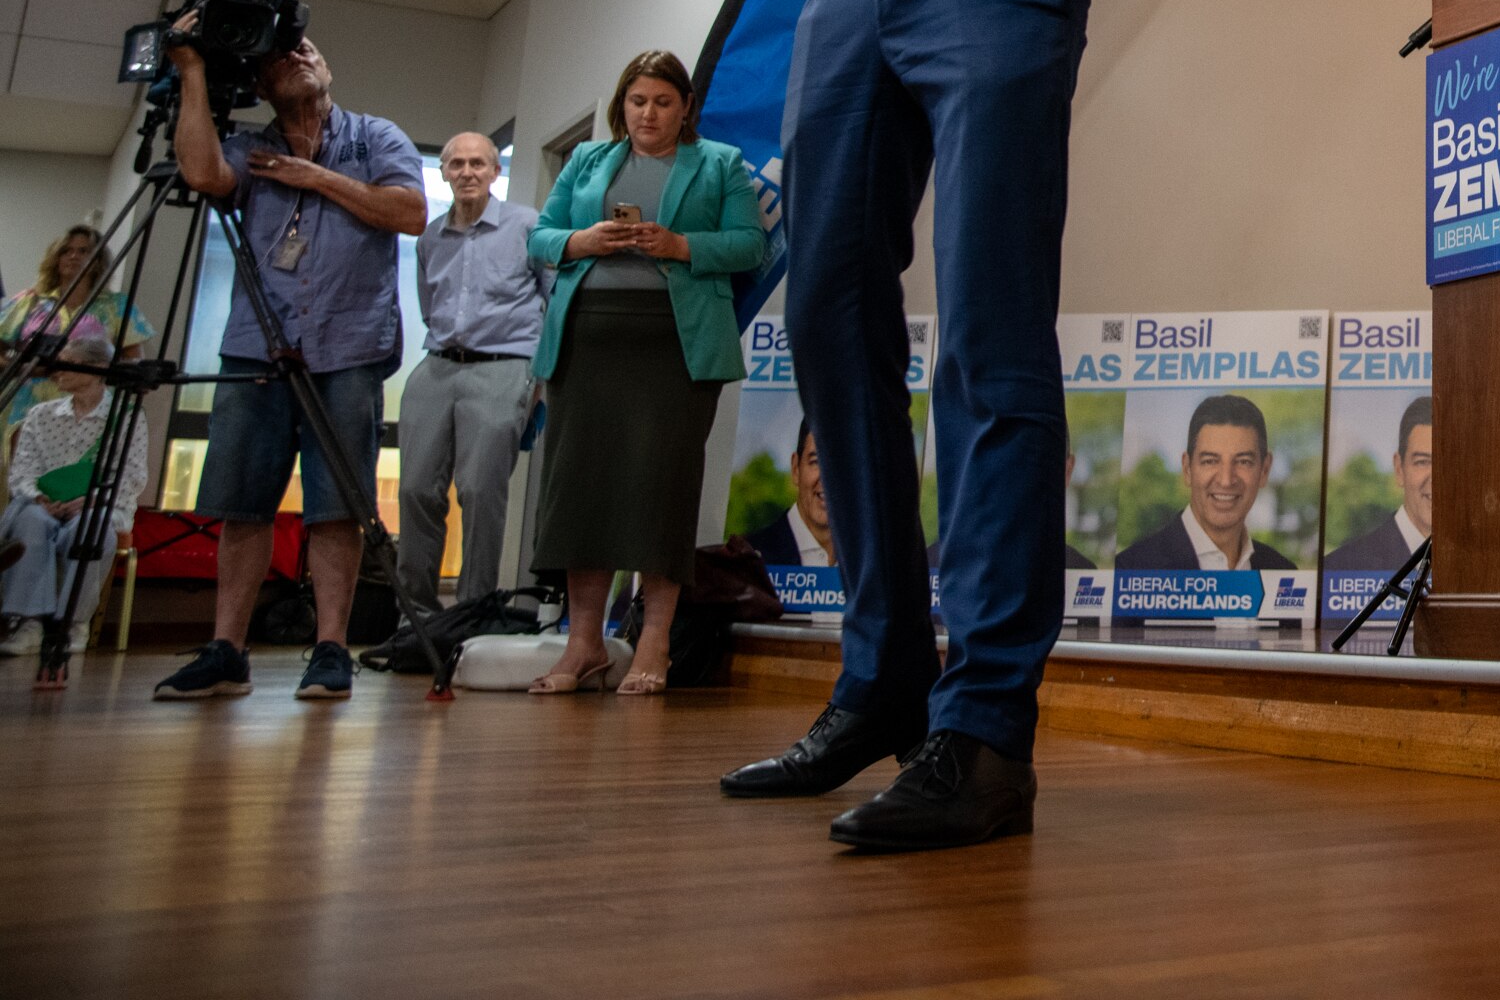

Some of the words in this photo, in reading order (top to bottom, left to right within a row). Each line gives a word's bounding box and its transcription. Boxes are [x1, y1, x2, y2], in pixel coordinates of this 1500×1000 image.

[1434, 55, 1500, 117] We're
[1437, 222, 1490, 252] LIBERAL
[1135, 318, 1213, 349] Basil
[1339, 317, 1420, 348] Basil
[1133, 350, 1321, 381] ZEMPILAS
[785, 572, 817, 588] FOR
[1119, 577, 1182, 592] LIBERAL
[1184, 577, 1217, 592] FOR
[1329, 577, 1387, 593] LIBERA
[779, 589, 847, 606] HLANDS
[1118, 594, 1253, 610] CHURCHLANDS
[1274, 597, 1306, 607] LIBERAL
